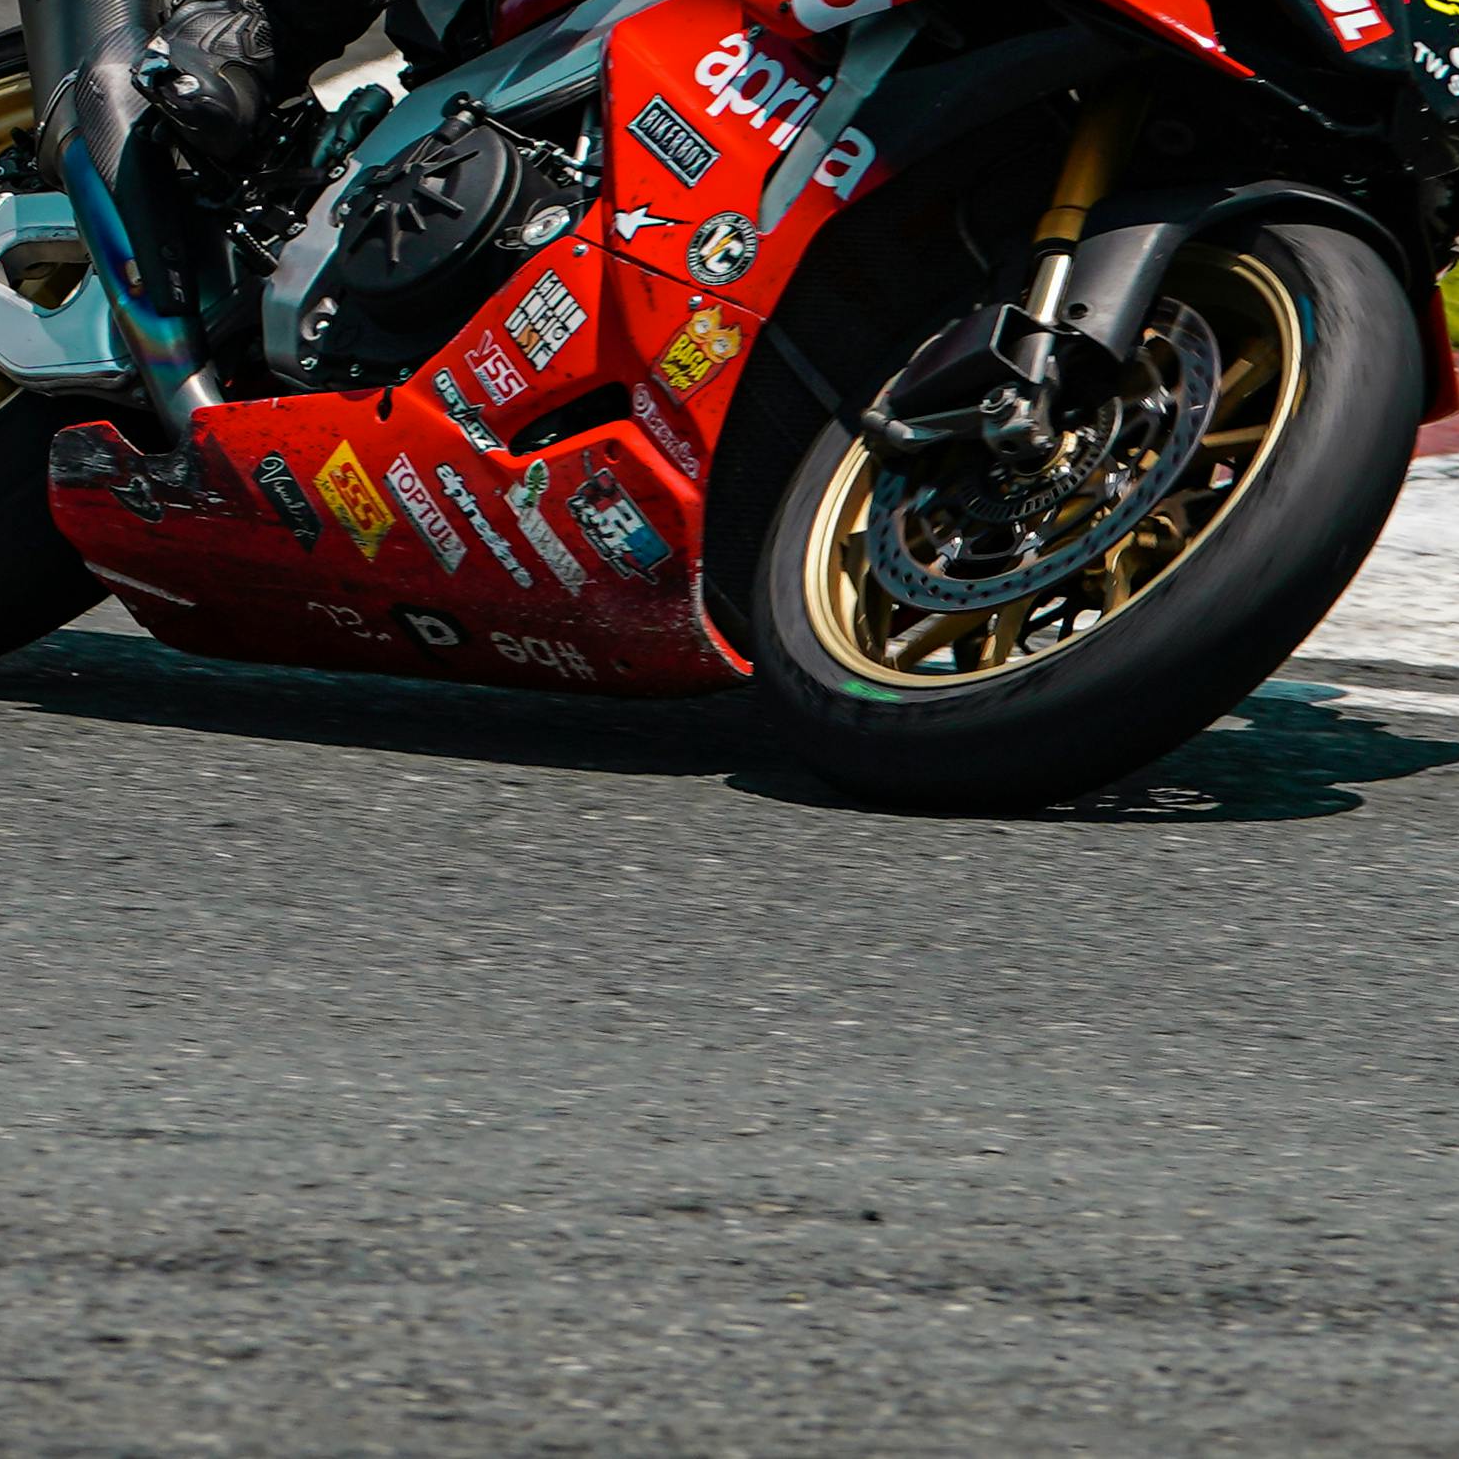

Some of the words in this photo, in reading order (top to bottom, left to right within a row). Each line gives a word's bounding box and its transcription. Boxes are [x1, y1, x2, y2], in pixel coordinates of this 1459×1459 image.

[1413, 41, 1449, 80] TW
[641, 107, 708, 175] BIKERBOX
[694, 32, 876, 200] apria
[464, 330, 528, 401] YSS
